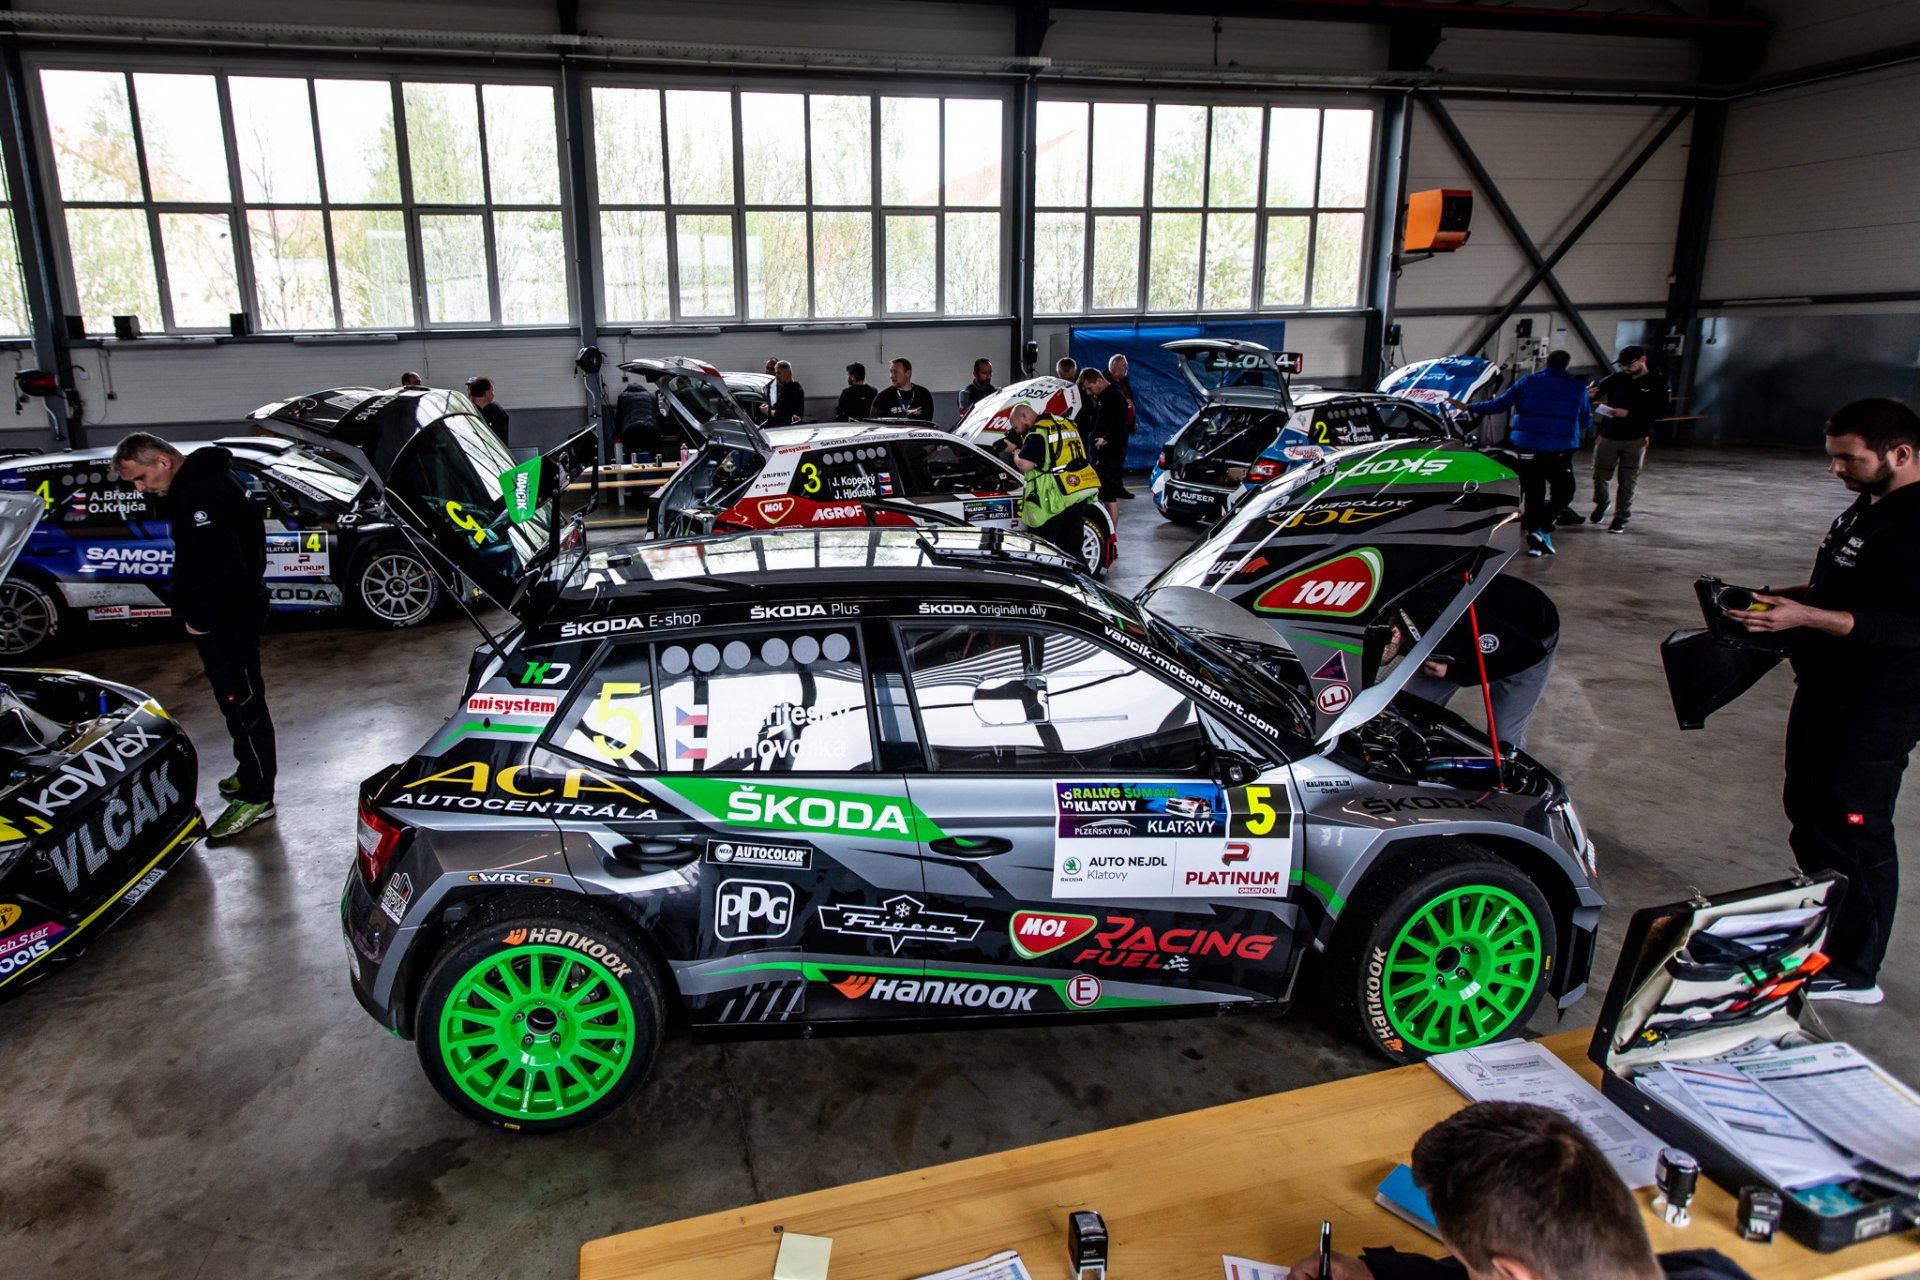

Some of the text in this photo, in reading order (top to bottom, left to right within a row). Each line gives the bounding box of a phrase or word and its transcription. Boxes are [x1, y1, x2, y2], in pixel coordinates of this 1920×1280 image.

[1315, 421, 1330, 443] 2
[801, 463, 822, 494] 3
[832, 474, 876, 487] J. Kopecký
[35, 480, 54, 510] 4
[834, 490, 843, 500] J.
[1180, 492, 1215, 504] AUFEER
[764, 503, 784, 513] MOL
[811, 504, 867, 521] AGROF
[445, 501, 487, 544] 5
[306, 533, 322, 552] 4
[86, 547, 176, 562] SAMOH
[118, 563, 174, 575] MOT
[750, 603, 860, 620] ŠKODA Plus
[918, 602, 977, 614] ŠKODA
[560, 612, 702, 637] ŠKODA E-shop
[1103, 625, 1280, 740] vancik-motorsport.com
[1321, 689, 1347, 708] E
[593, 682, 643, 760] 5
[402, 762, 651, 804] ACA
[391, 792, 659, 821] AUTOCENTRÁLA
[727, 783, 911, 837] ŠKODA
[1074, 800, 1137, 812] KLATOVY
[1245, 786, 1277, 836] 5
[1361, 795, 1494, 817] ŠKODA
[50, 760, 180, 893] VLČÁK
[1074, 825, 1131, 837] PLZEŇSKÝ KRAJ
[1088, 856, 1168, 868] AUTO NEJDL
[467, 872, 554, 885] eWRC.cz
[1086, 869, 1129, 882] Klatovy
[1185, 871, 1280, 886] PLATINUM
[1239, 887, 1277, 895] ORLEN OIL
[1019, 917, 1068, 938] MOL
[1094, 915, 1279, 960] RACING
[1072, 949, 1166, 969] FUEL
[1075, 978, 1092, 1001] E
